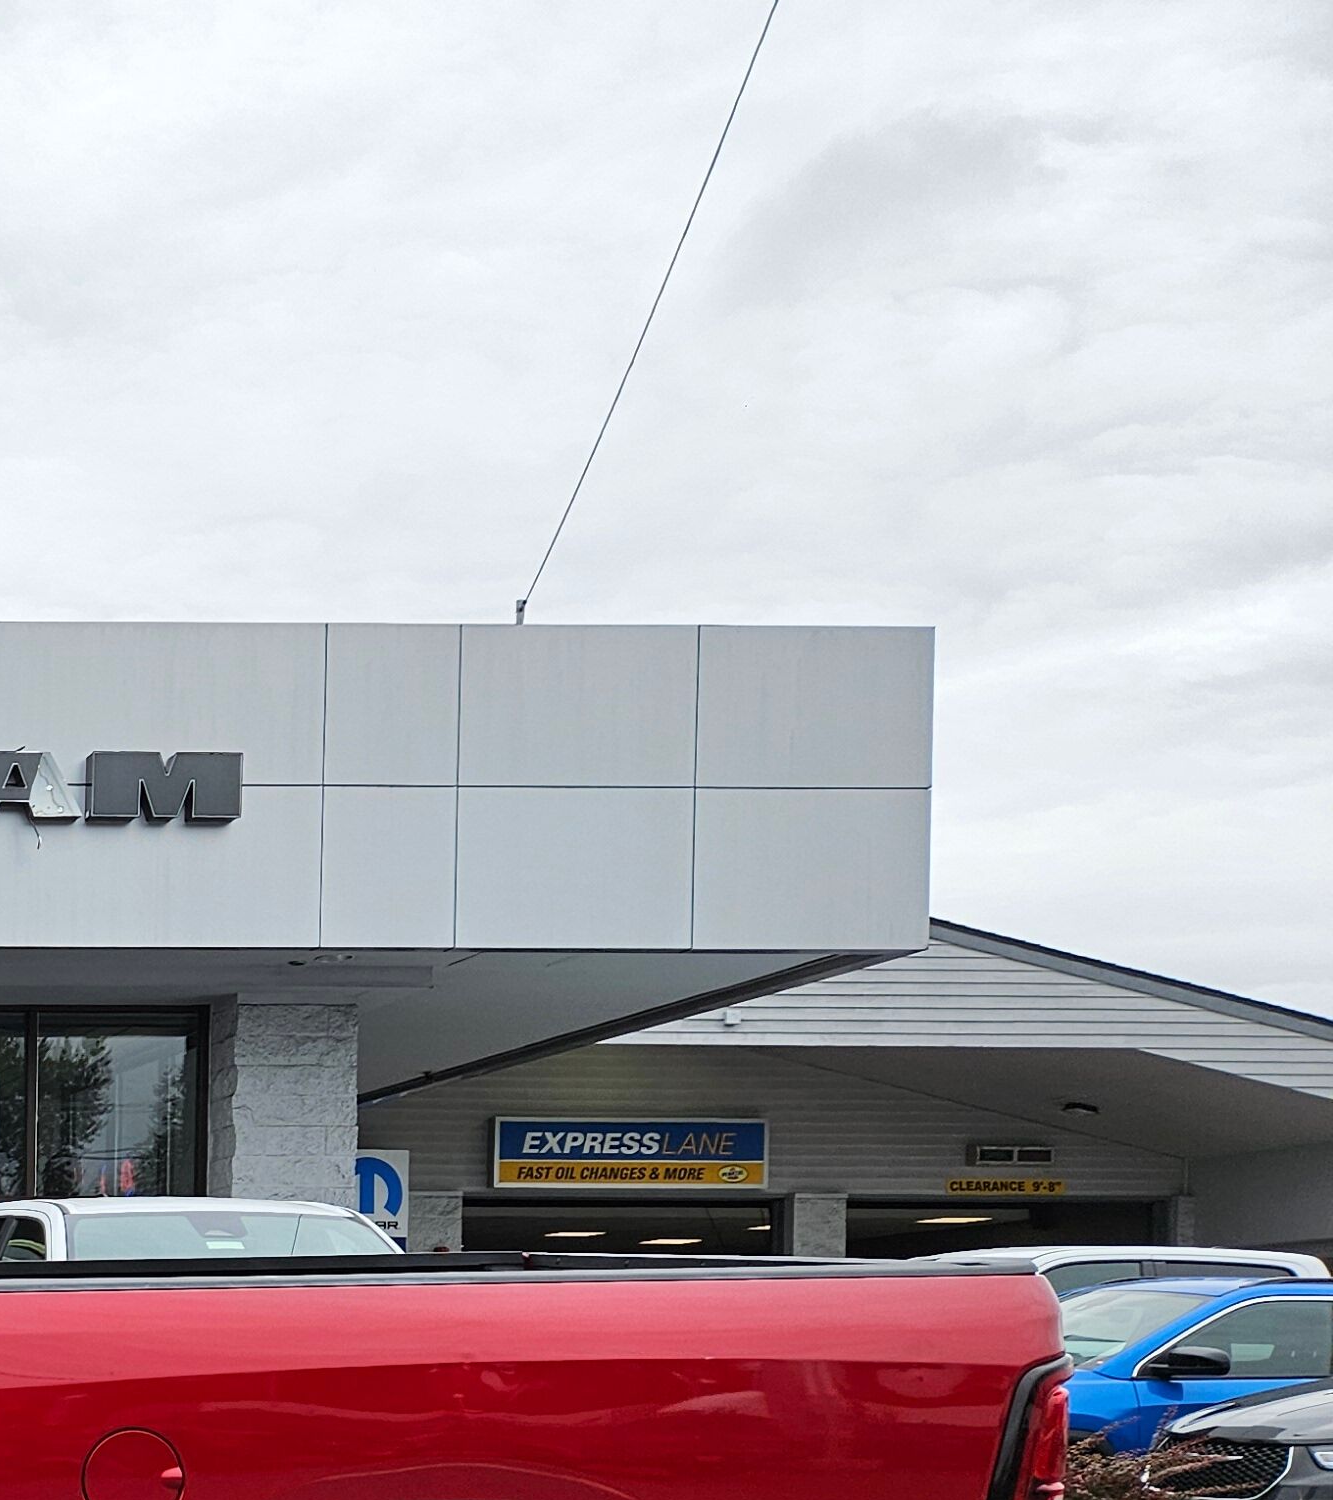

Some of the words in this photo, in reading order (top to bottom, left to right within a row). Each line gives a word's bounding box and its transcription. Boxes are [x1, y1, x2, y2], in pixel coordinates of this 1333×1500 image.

[517, 1166, 553, 1180] FAST
[555, 1166, 577, 1180] OIL
[580, 1166, 646, 1181] CHANGES
[646, 1166, 659, 1180] &
[663, 1167, 706, 1180] MORE
[949, 1181, 1026, 1192] CLEARANCE
